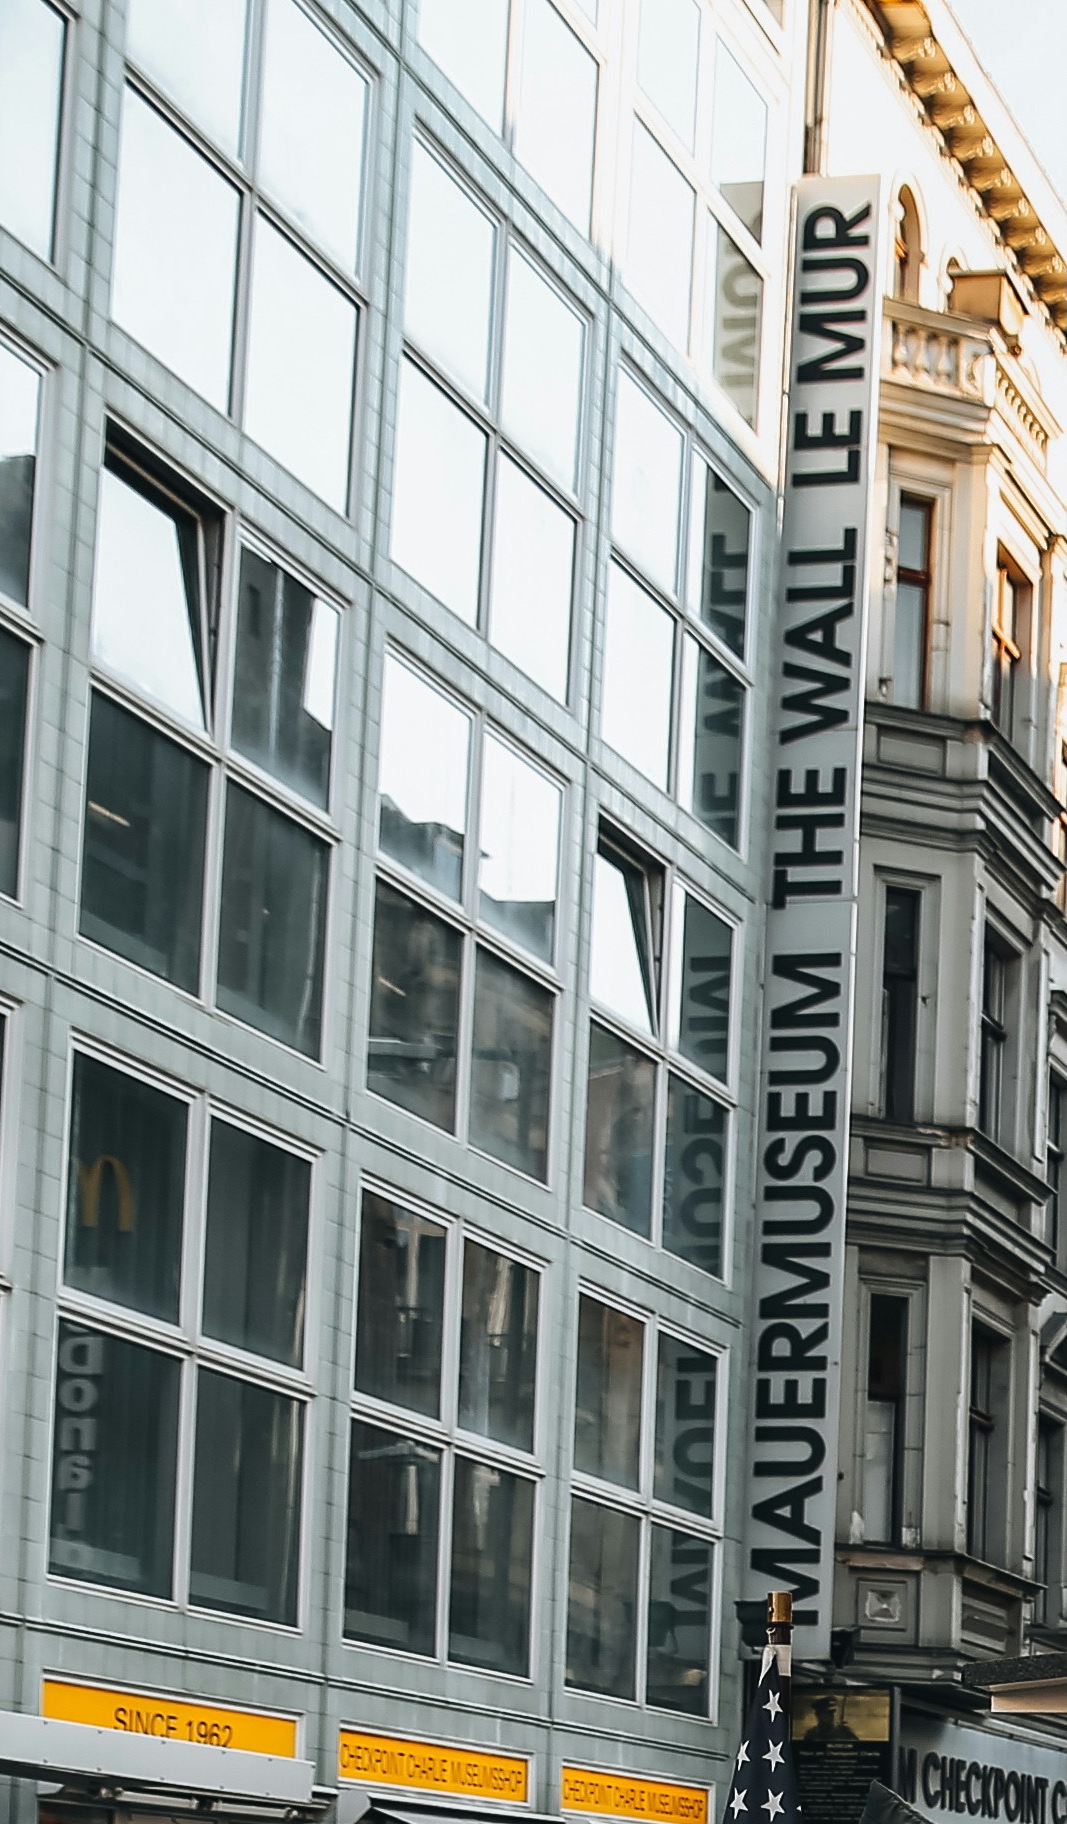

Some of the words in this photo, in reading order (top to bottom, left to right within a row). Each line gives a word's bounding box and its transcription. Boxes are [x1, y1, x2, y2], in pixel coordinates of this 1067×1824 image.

[795, 200, 872, 382] MUR
[792, 409, 862, 487] LE
[779, 526, 857, 746] WALL
[773, 765, 847, 908] THE
[750, 952, 842, 1626] MAUERMUSEUM
[114, 1707, 178, 1738] SINCE
[186, 1720, 233, 1748] 1962
[341, 1743, 406, 1776] CHECKPOINT
[408, 1754, 448, 1783] CHARLIE
